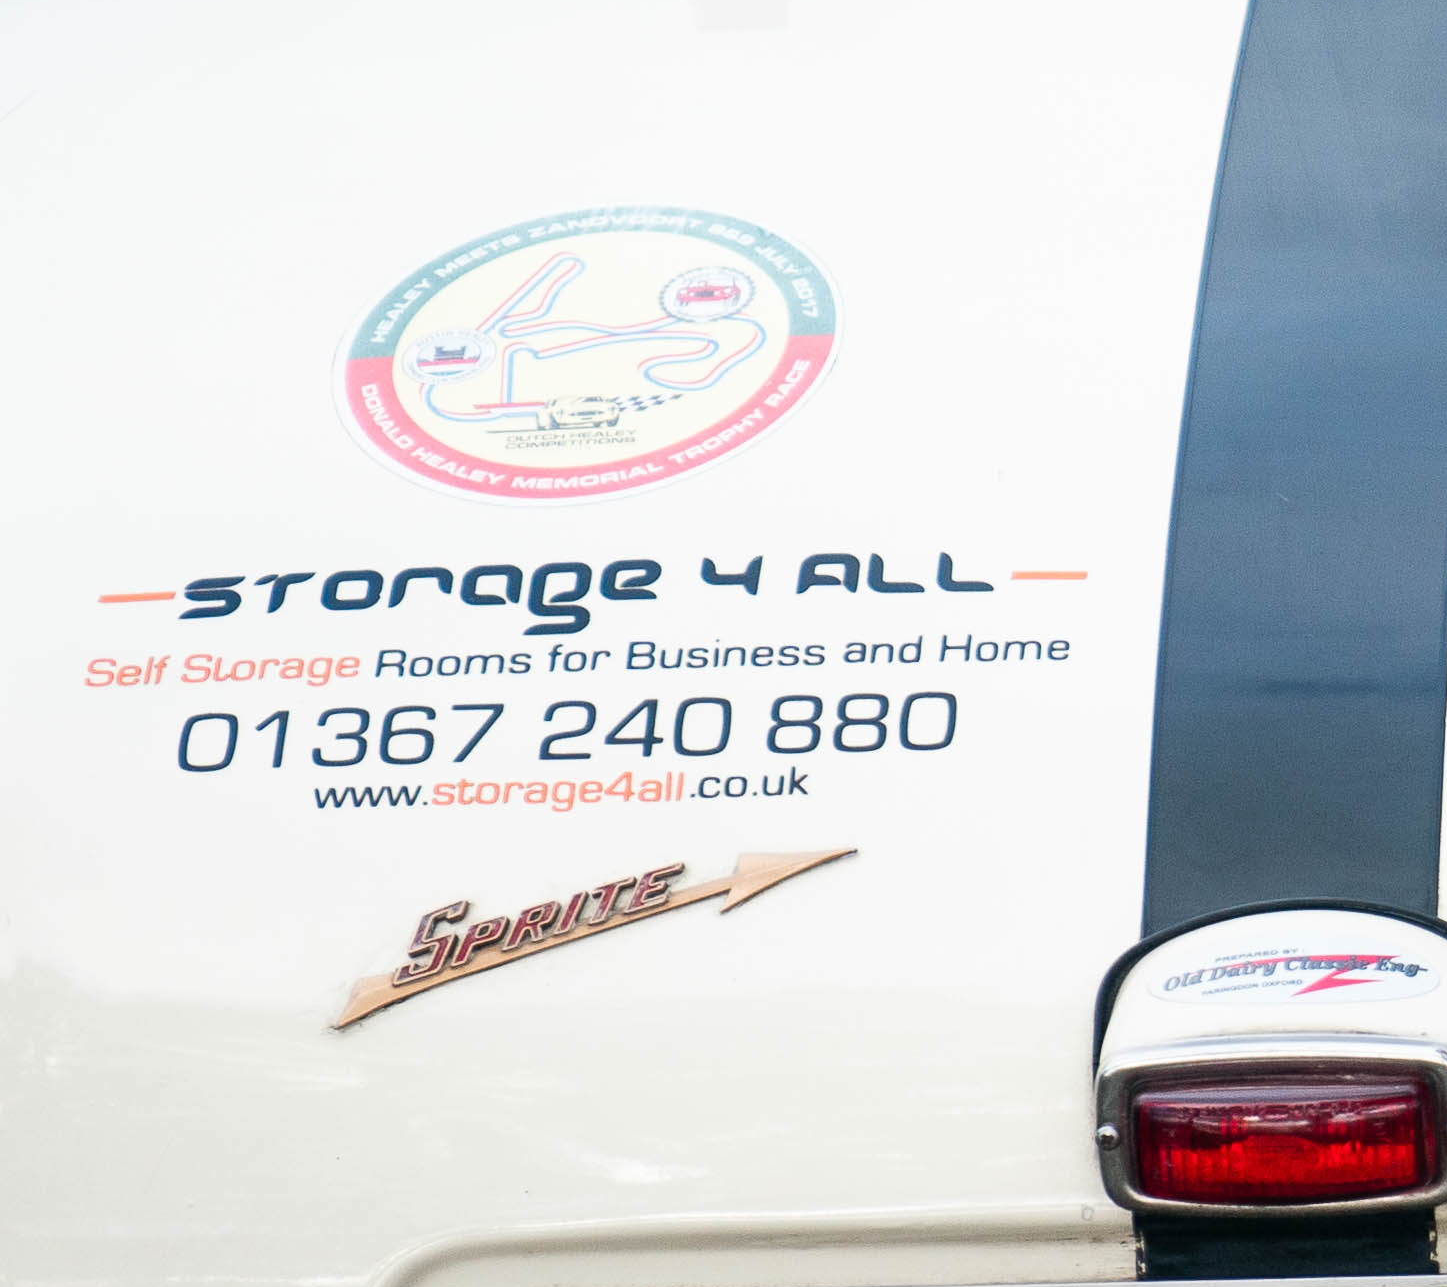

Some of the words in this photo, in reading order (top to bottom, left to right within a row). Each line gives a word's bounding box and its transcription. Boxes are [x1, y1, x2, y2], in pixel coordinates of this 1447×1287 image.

[371, 280, 433, 344] HEALEY
[434, 233, 523, 275] MEETS
[360, 382, 414, 451] DONALD
[411, 445, 506, 487] HEALEY
[510, 462, 665, 491] MEMORIAL
[667, 408, 767, 465] TROPHY
[765, 357, 811, 407] RACE
[796, 551, 996, 595] ALL
[84, 652, 169, 689] Self
[181, 649, 361, 689] Storage
[374, 648, 533, 680] Rooms
[546, 641, 611, 675] for
[624, 636, 827, 671] Business
[841, 633, 924, 666] and
[939, 631, 1071, 663] Home
[177, 702, 506, 773] 01367
[537, 695, 732, 762] 240
[764, 690, 958, 755] 880
[313, 764, 810, 813] www.storage4all.co.uk
[1163, 968, 1206, 992] Old
[1209, 959, 1279, 984] Dairy
